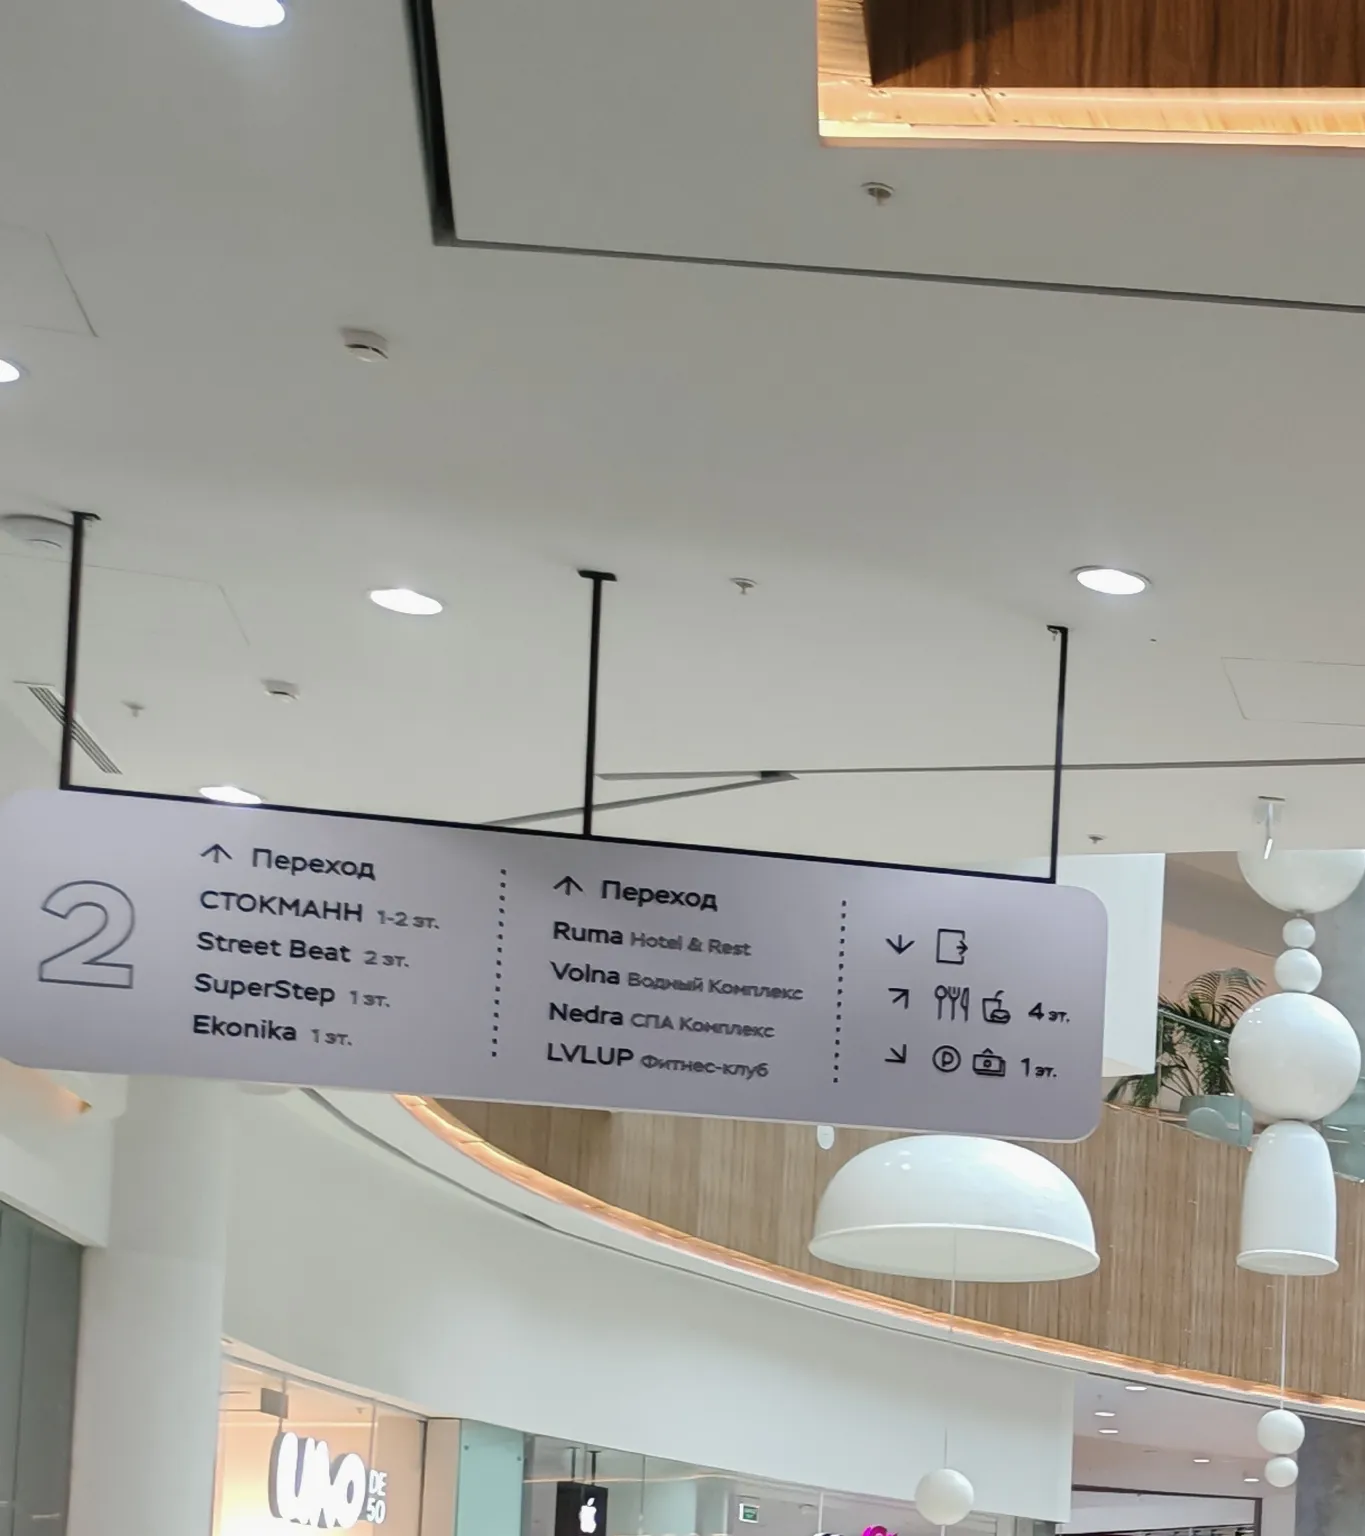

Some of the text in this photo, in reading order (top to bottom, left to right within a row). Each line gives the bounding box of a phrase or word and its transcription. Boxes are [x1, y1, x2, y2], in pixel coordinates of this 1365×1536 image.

[252, 847, 376, 881] Переход
[200, 890, 440, 930] СТОКМАНН 1-2 эт.
[601, 880, 718, 912] Переход
[38, 880, 136, 989] 2
[197, 931, 410, 968] Street Beat 2 эт.
[553, 921, 752, 957] Ruma Hotel & Rest
[194, 973, 391, 1008] SuperStep 1 эт.
[549, 960, 804, 1001] Volna Водный Комплекс
[193, 1014, 353, 1046] Ekonika 1 эт.
[549, 1002, 776, 1039] Nedra СПА Комплекс
[1028, 1002, 1071, 1023] 4 эт.
[547, 1042, 770, 1081] LVLUP Фитнес-клуб
[1021, 1057, 1031, 1078] 1
[1034, 1066, 1058, 1078] эт.
[368, 1468, 388, 1497] DE
[366, 1497, 386, 1525] 50
